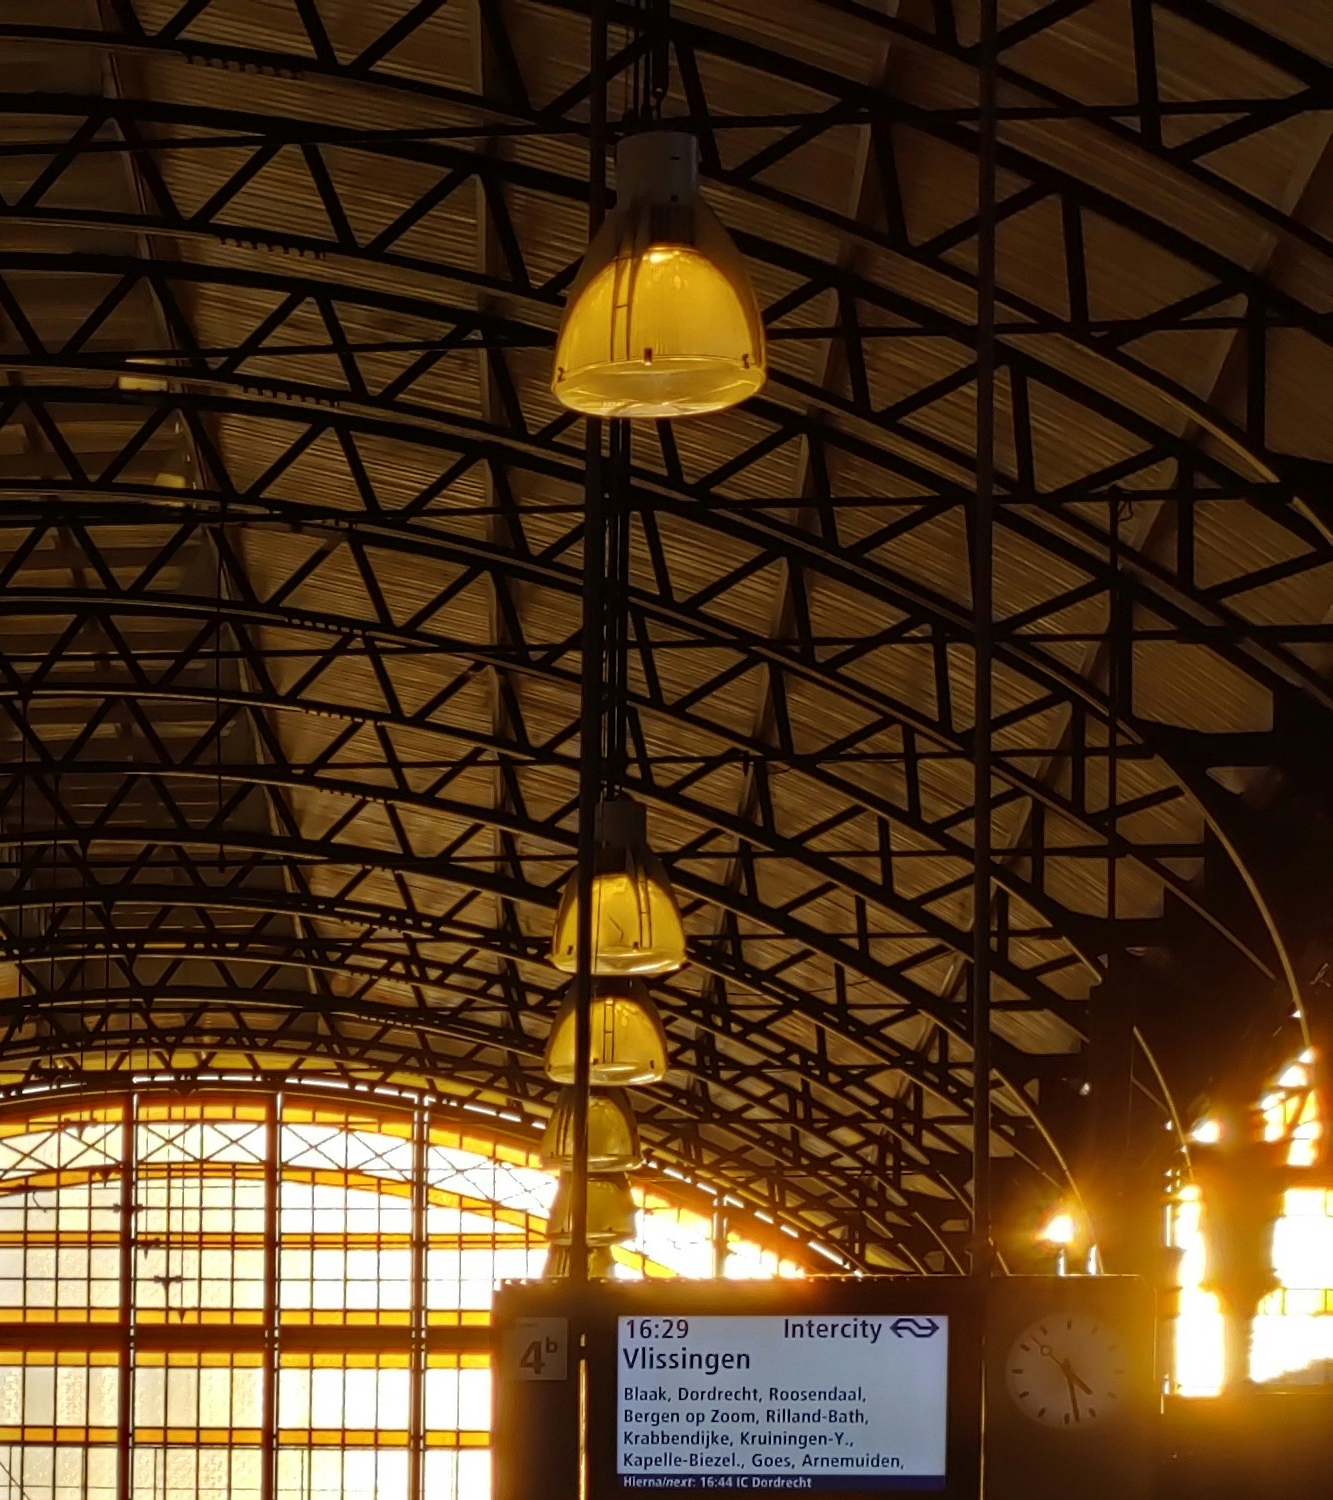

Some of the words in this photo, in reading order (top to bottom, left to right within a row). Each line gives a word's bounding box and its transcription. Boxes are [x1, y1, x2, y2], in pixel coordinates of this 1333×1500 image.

[626, 1319, 689, 1339] 16:29
[784, 1317, 882, 1343] Intercity
[623, 1347, 751, 1375] Vlissingen
[624, 1387, 672, 1402] Blaak,
[678, 1387, 763, 1402] Dordrecht,
[769, 1387, 867, 1402] Roosendaal,
[624, 1410, 680, 1426] Bergen
[685, 1413, 705, 1426] op
[711, 1410, 760, 1425] Zoom,
[766, 1409, 869, 1426] Rilland-Bath,
[624, 1431, 734, 1449] Krabbendijke,
[740, 1431, 854, 1449] Kruiningen-Y.,
[623, 1453, 745, 1470] Kapelle-Biezel.,
[751, 1454, 796, 1469] Goes,
[802, 1453, 905, 1470] Arnemuiden,
[700, 1476, 732, 1488] 16:44
[736, 1477, 748, 1488] IC
[752, 1476, 812, 1488] Dordrecht
